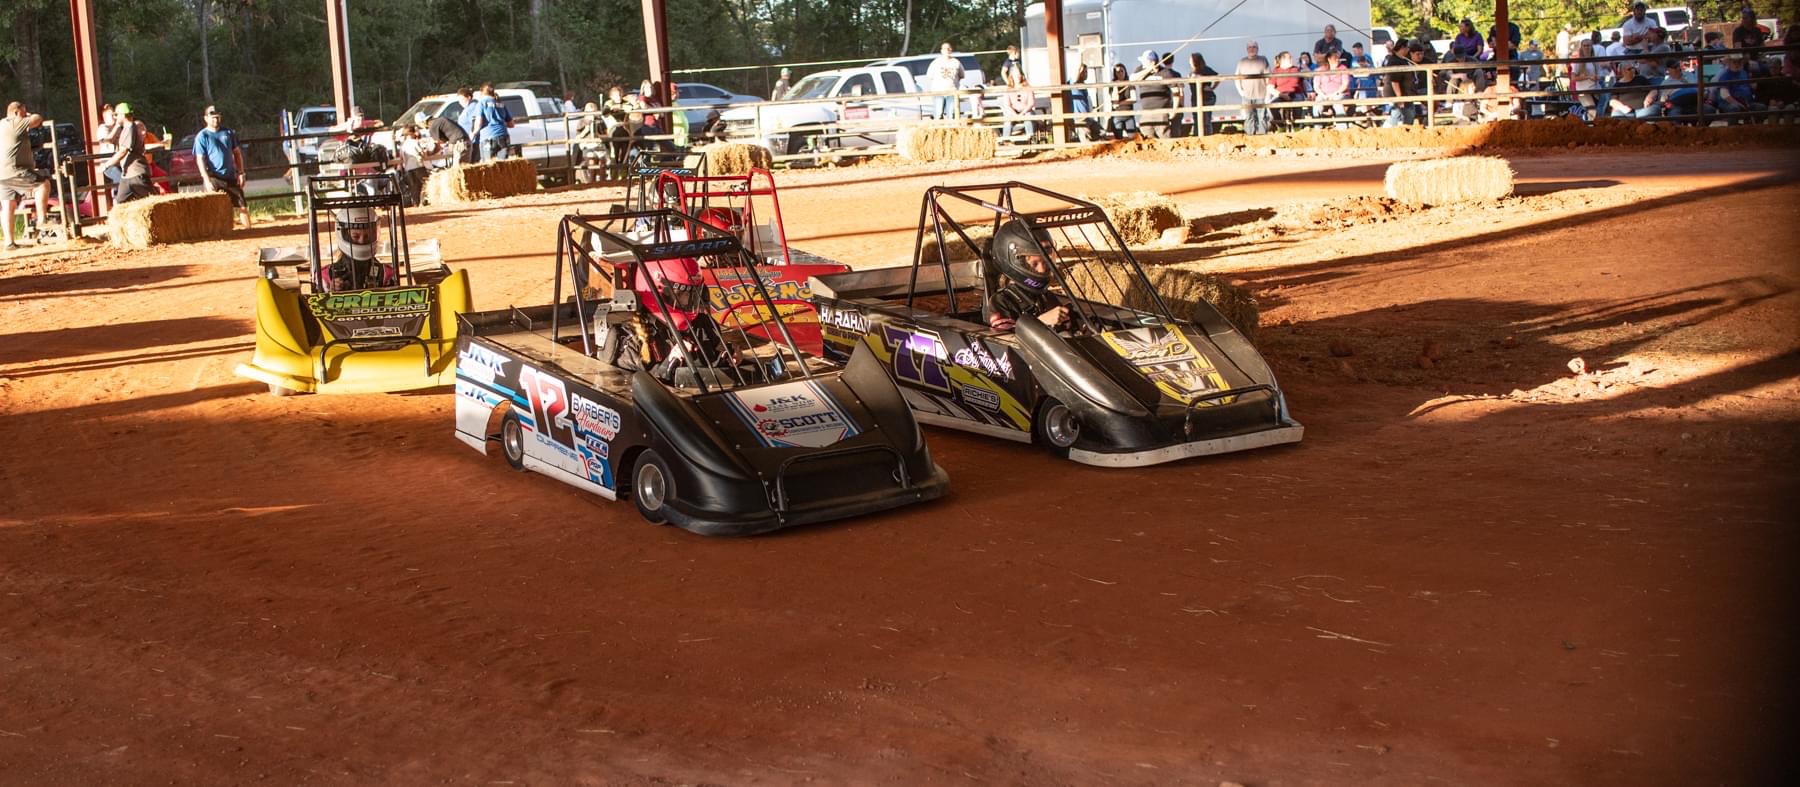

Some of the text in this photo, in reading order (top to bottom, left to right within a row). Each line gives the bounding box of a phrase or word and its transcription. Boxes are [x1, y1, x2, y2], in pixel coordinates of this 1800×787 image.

[326, 289, 426, 310] GRIFFIN
[351, 303, 426, 314] SOLUTIONS
[821, 305, 871, 336] HARAHAN
[881, 322, 952, 394] 77
[519, 364, 577, 451] 12
[964, 388, 998, 404] RICHIE'S
[572, 395, 620, 431] BARBER'S
[577, 410, 614, 440] Hardware
[780, 412, 836, 428] SCOTT
